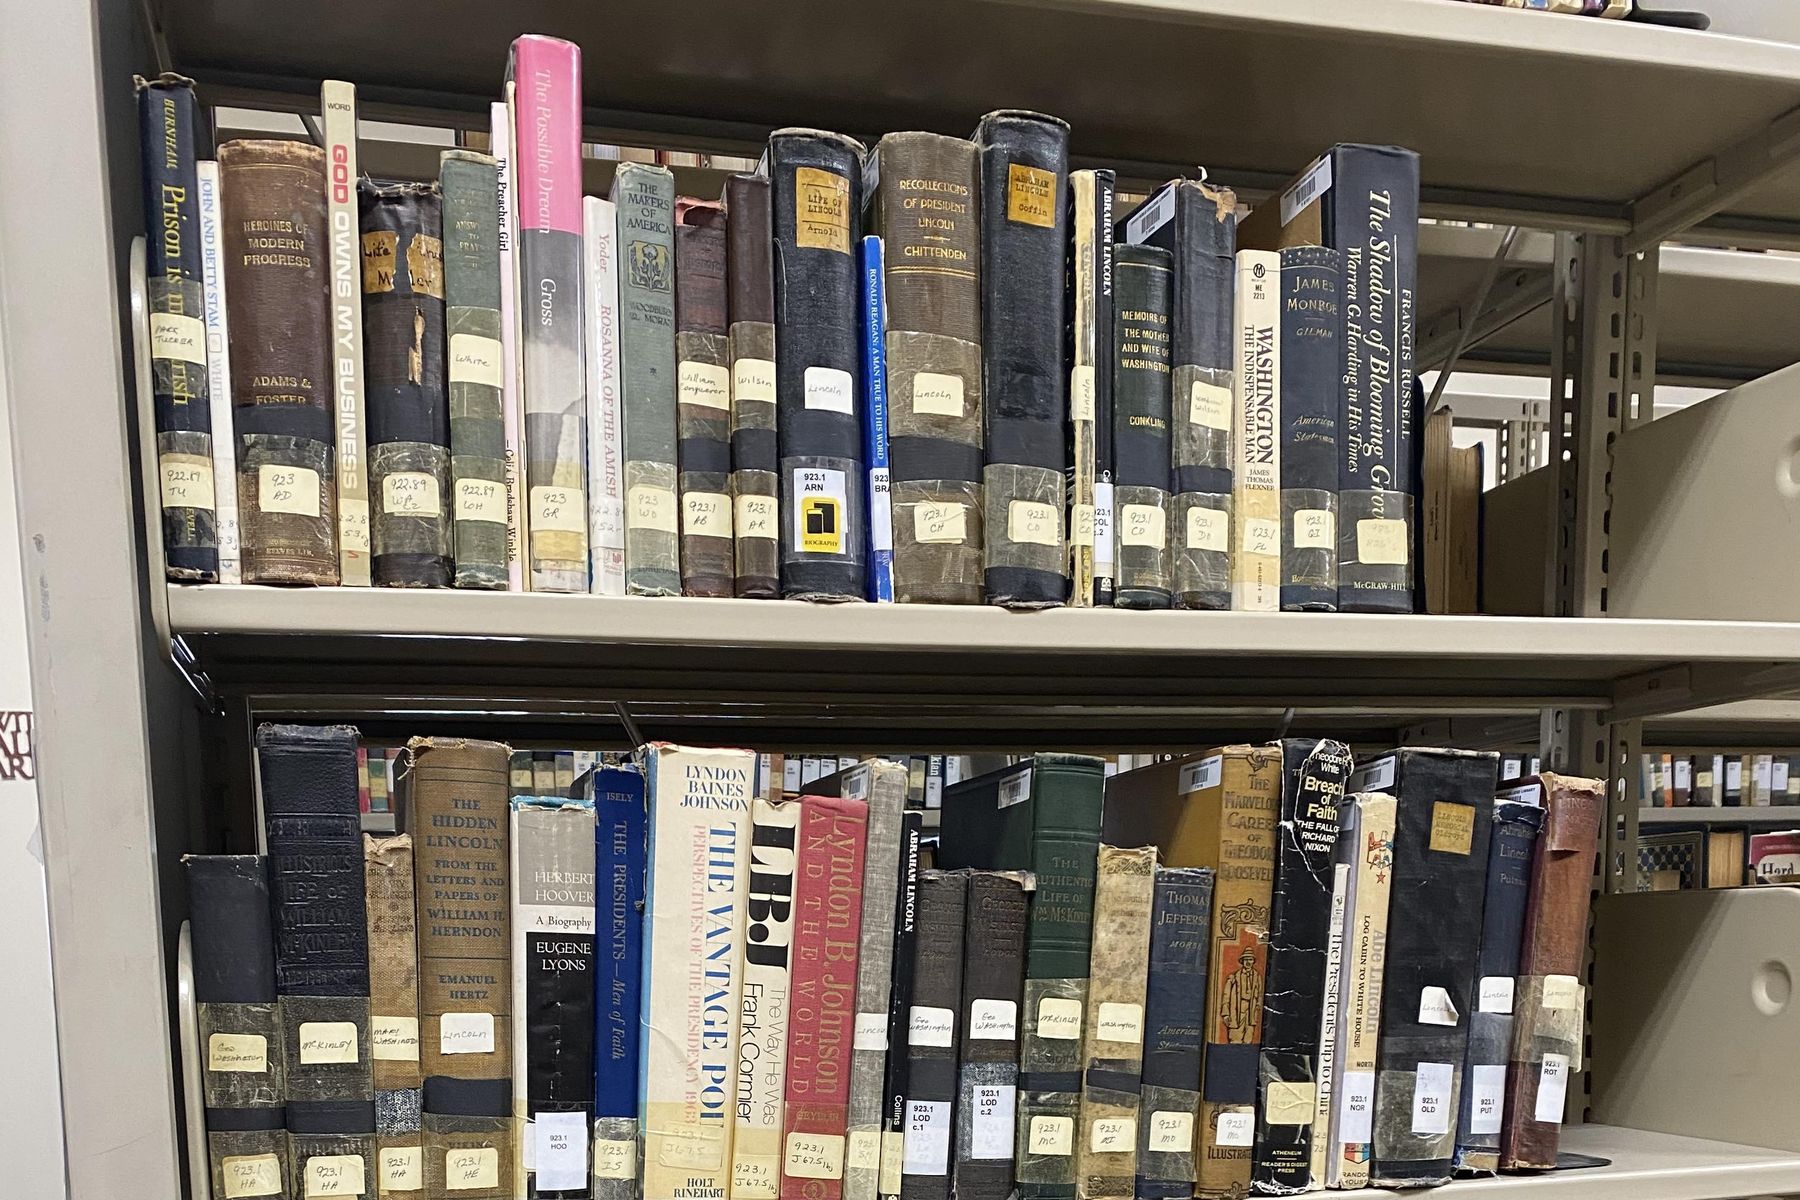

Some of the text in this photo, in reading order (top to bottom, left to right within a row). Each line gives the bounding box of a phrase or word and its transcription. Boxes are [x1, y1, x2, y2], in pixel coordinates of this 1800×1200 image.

[328, 103, 351, 112] WORD
[536, 69, 554, 233] The Possible Dream
[638, 183, 658, 195] THE
[900, 180, 968, 195] RECOLLECTIONS
[628, 194, 670, 209] MAKERS
[1369, 190, 1391, 232] The
[162, 184, 190, 284] Prison is
[627, 219, 671, 235] AMERICA
[248, 239, 305, 251] MODERN
[1103, 187, 1113, 296] ABRAHAM LINCOLN
[243, 255, 311, 267] PROGRESS
[904, 247, 967, 260] CHITTENDEN
[1293, 276, 1335, 293] JAMES
[1370, 236, 1391, 325] Shadow
[541, 279, 556, 326] Gross
[1287, 298, 1338, 316] MONROE
[333, 144, 358, 489] GOD OWNS MY BUSINESS
[1363, 330, 1391, 355] of
[1122, 359, 1170, 374] WASHINGTON
[1402, 289, 1412, 440] FRANCIS RUSSELL
[600, 305, 617, 498] ROSANNA OF THE AMISH
[1256, 327, 1273, 464] WASHINGTON
[1363, 356, 1391, 457] Blooming
[1129, 416, 1166, 429] CONKLING
[272, 474, 295, 485] 923
[1370, 464, 1391, 520] Grov
[1354, 580, 1407, 592] McGRAW-HILL
[686, 765, 747, 782] LYNDON
[689, 780, 744, 796] BAINES
[680, 794, 748, 812] JOHNSON
[1306, 803, 1338, 820] Faith
[432, 815, 497, 829] HIDDEN
[426, 836, 503, 850] LINCOLN
[613, 820, 627, 855] THE
[1302, 831, 1336, 843] RICHARD
[1305, 843, 1331, 853] NIXON
[708, 821, 737, 892] THE
[535, 871, 595, 885] HERBERT
[905, 829, 919, 933] ABRAHAM LINCOLN
[535, 890, 594, 902] HOOVER
[745, 822, 796, 973] LBJ
[432, 926, 502, 938] HERNDON
[536, 942, 591, 955] EUGENE
[791, 810, 826, 1094] AND THE WORLD
[815, 814, 866, 1094] Lyndon B. Johnson
[542, 960, 586, 971] LYONS
[438, 975, 498, 985] EMANUEL
[702, 904, 733, 1050] VANTAGE
[737, 983, 764, 1123] Frank Cormier
[913, 1105, 934, 1113] 923.1
[913, 1114, 931, 1122] LOD
[673, 1188, 725, 1198] RINEHART
